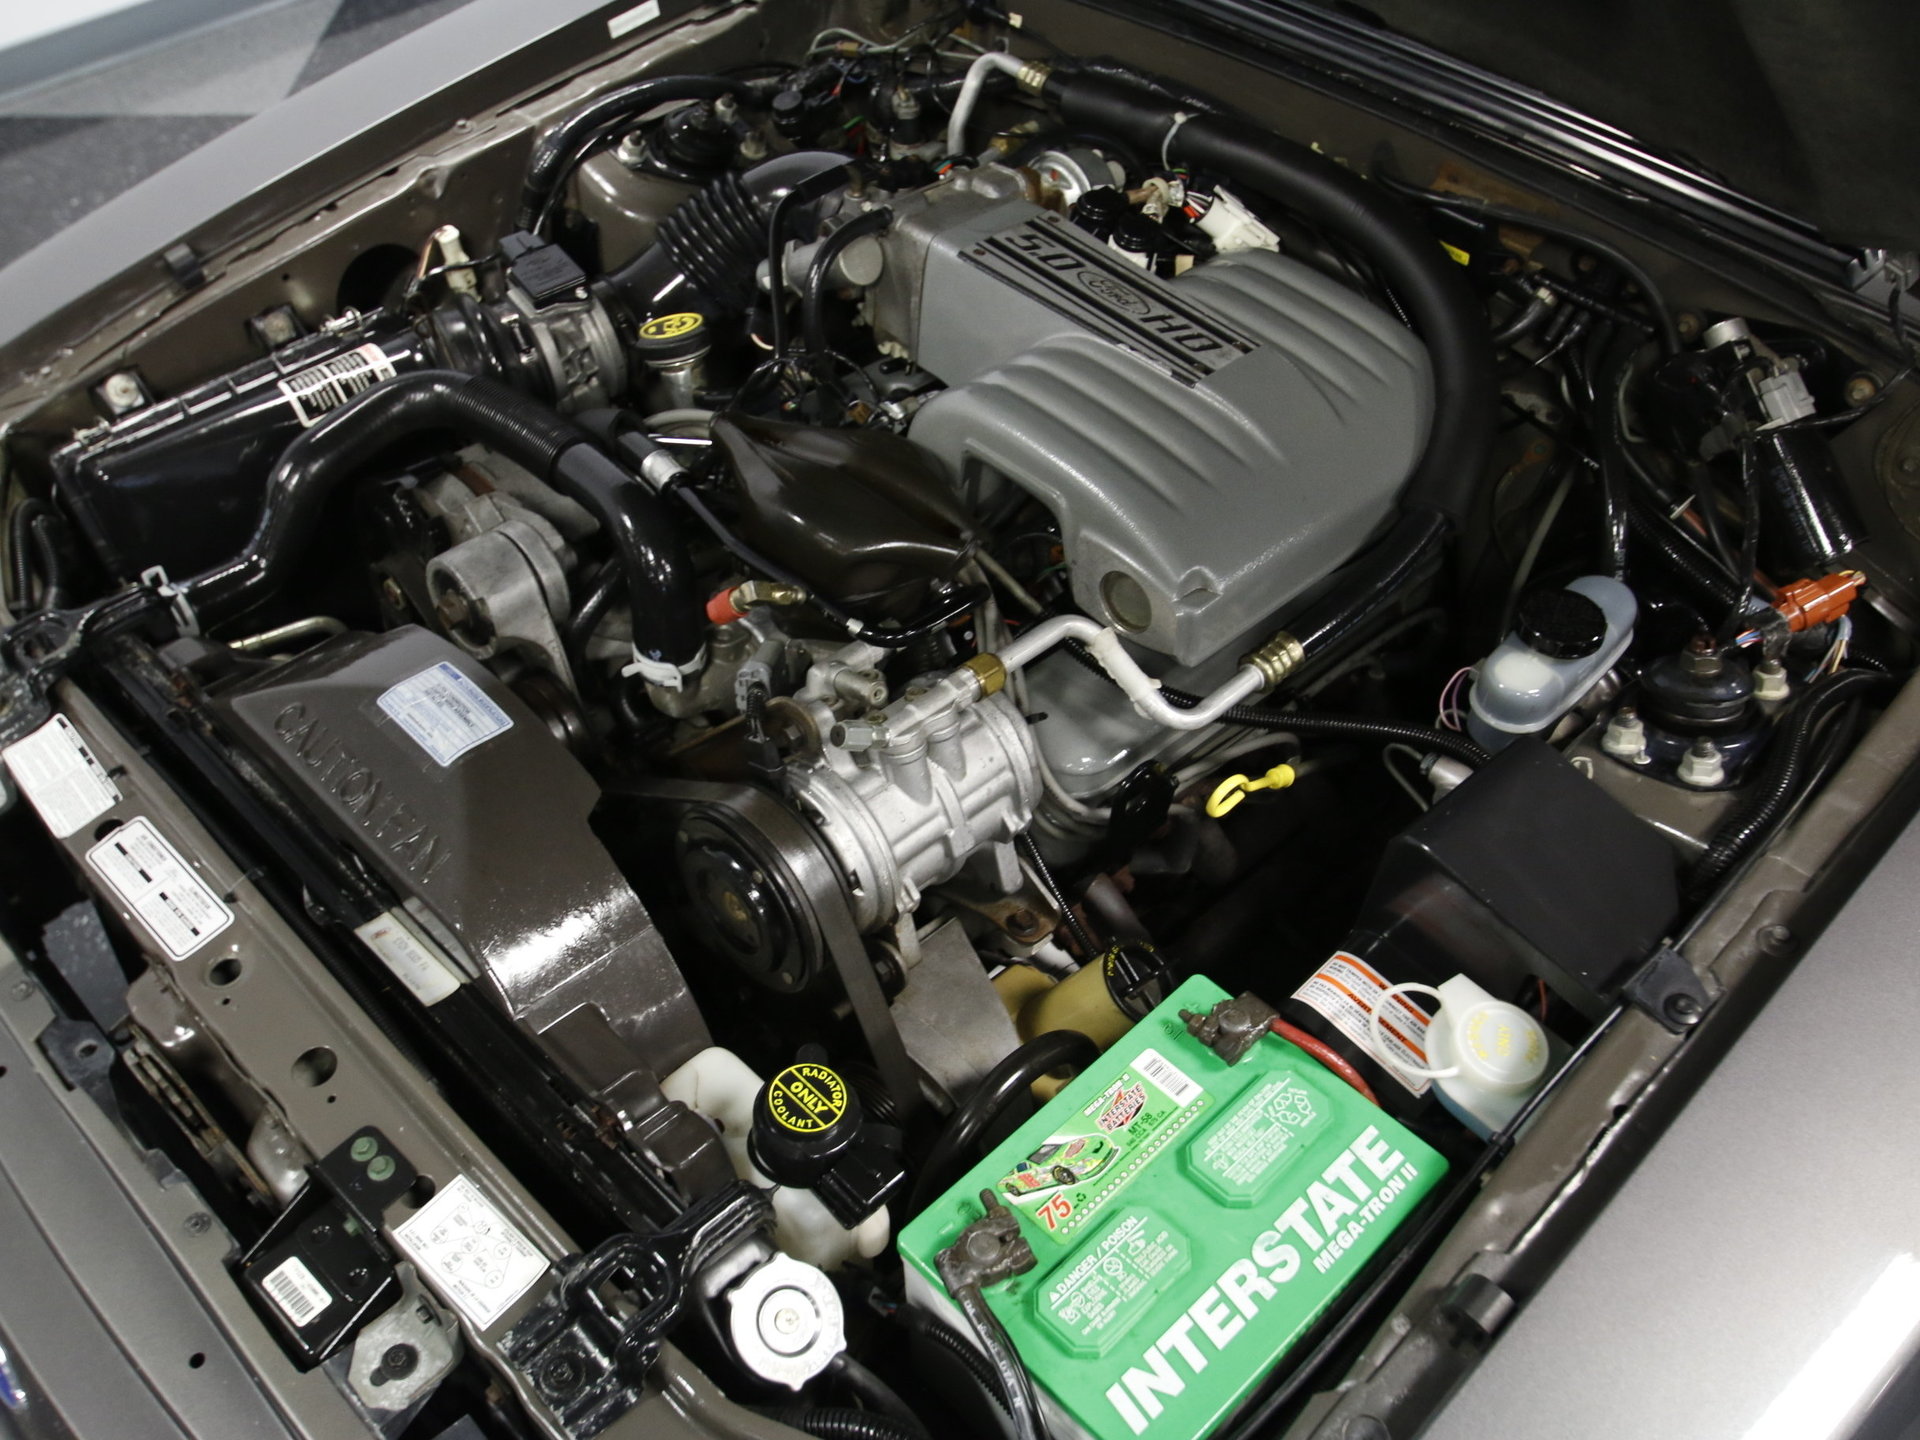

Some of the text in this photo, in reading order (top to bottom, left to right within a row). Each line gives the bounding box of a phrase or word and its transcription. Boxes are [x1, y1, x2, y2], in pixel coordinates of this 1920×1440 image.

[1006, 230, 1084, 272] 5.0
[1088, 276, 1139, 308] Ford
[373, 801, 455, 885] FAN
[1377, 981, 1415, 1014] WNING
[789, 1080, 829, 1113] ONLY
[802, 1066, 844, 1108] RADIATOR
[1098, 1085, 1143, 1127] INTERSTATE
[773, 1089, 814, 1129] COOLANT
[1106, 1094, 1145, 1130] BATTERIES
[1036, 1193, 1073, 1230] 75
[1312, 1162, 1418, 1274] MEGA-TRON II
[1055, 1253, 1097, 1294] DANGER
[1101, 1215, 1138, 1251] POISON
[1103, 1123, 1406, 1436] INTERSTATE
